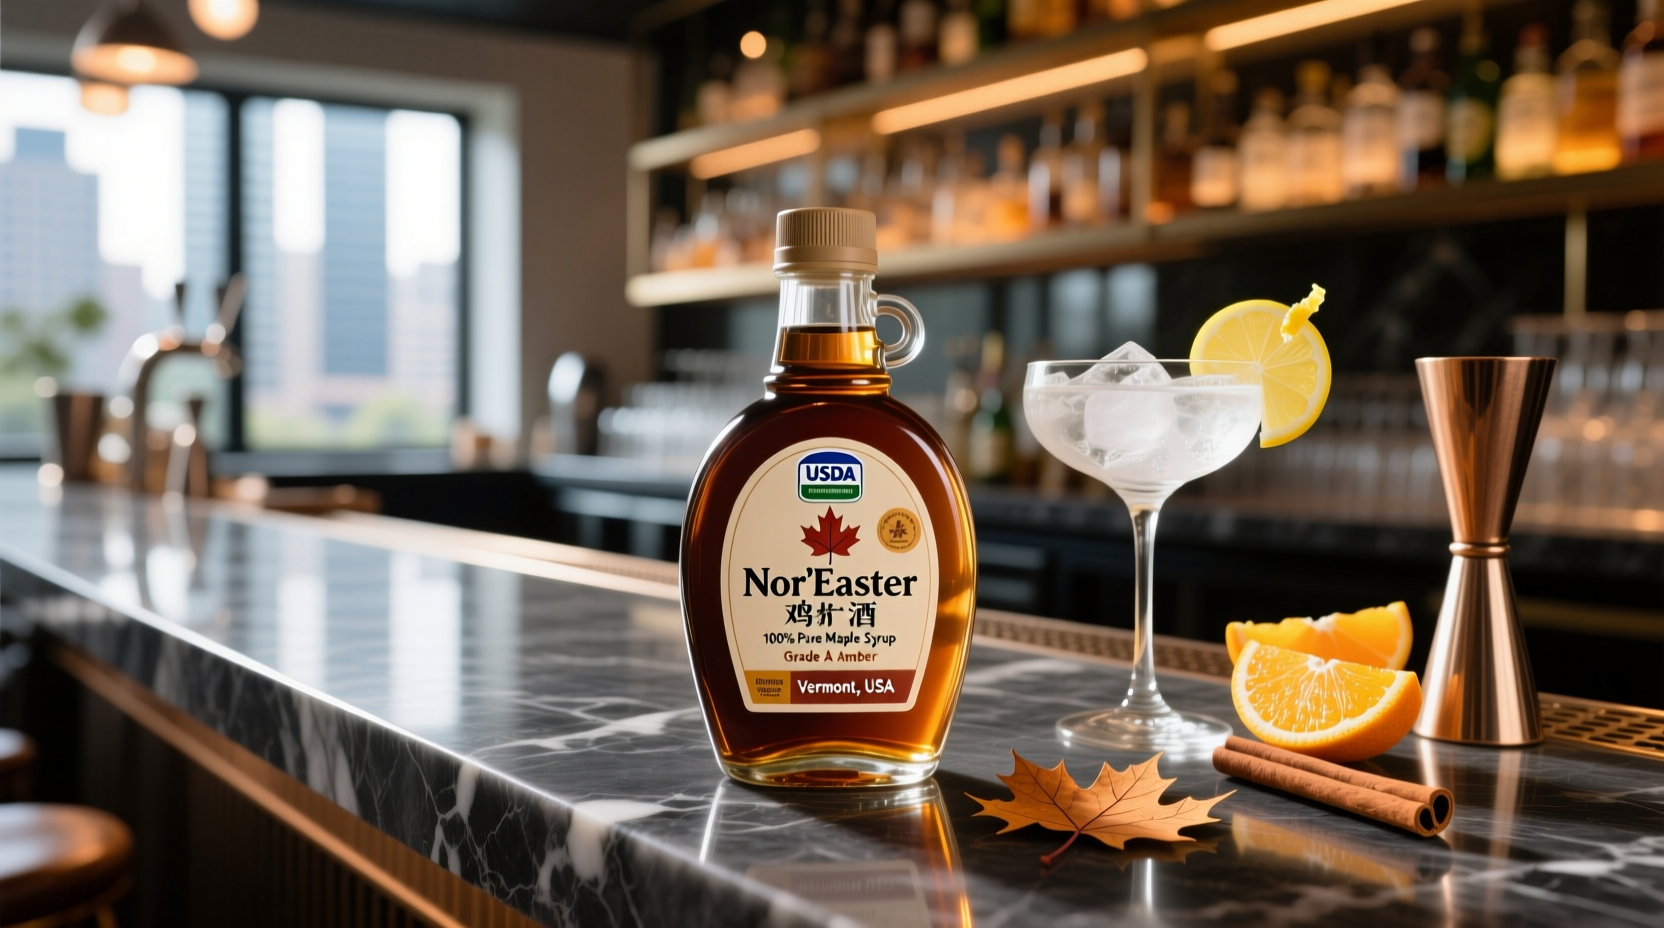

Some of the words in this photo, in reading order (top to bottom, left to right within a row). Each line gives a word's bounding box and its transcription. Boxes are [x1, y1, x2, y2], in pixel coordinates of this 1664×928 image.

[806, 465, 856, 481] USDA
[763, 633, 795, 644] 100%
[797, 633, 822, 644] Pure
[825, 632, 861, 648] Maple
[864, 632, 896, 648] Syrup
[784, 651, 820, 662] Grade
[824, 651, 833, 662] A
[837, 651, 878, 662] Amber
[797, 680, 861, 697] Vermont,
[864, 678, 895, 694] USA
